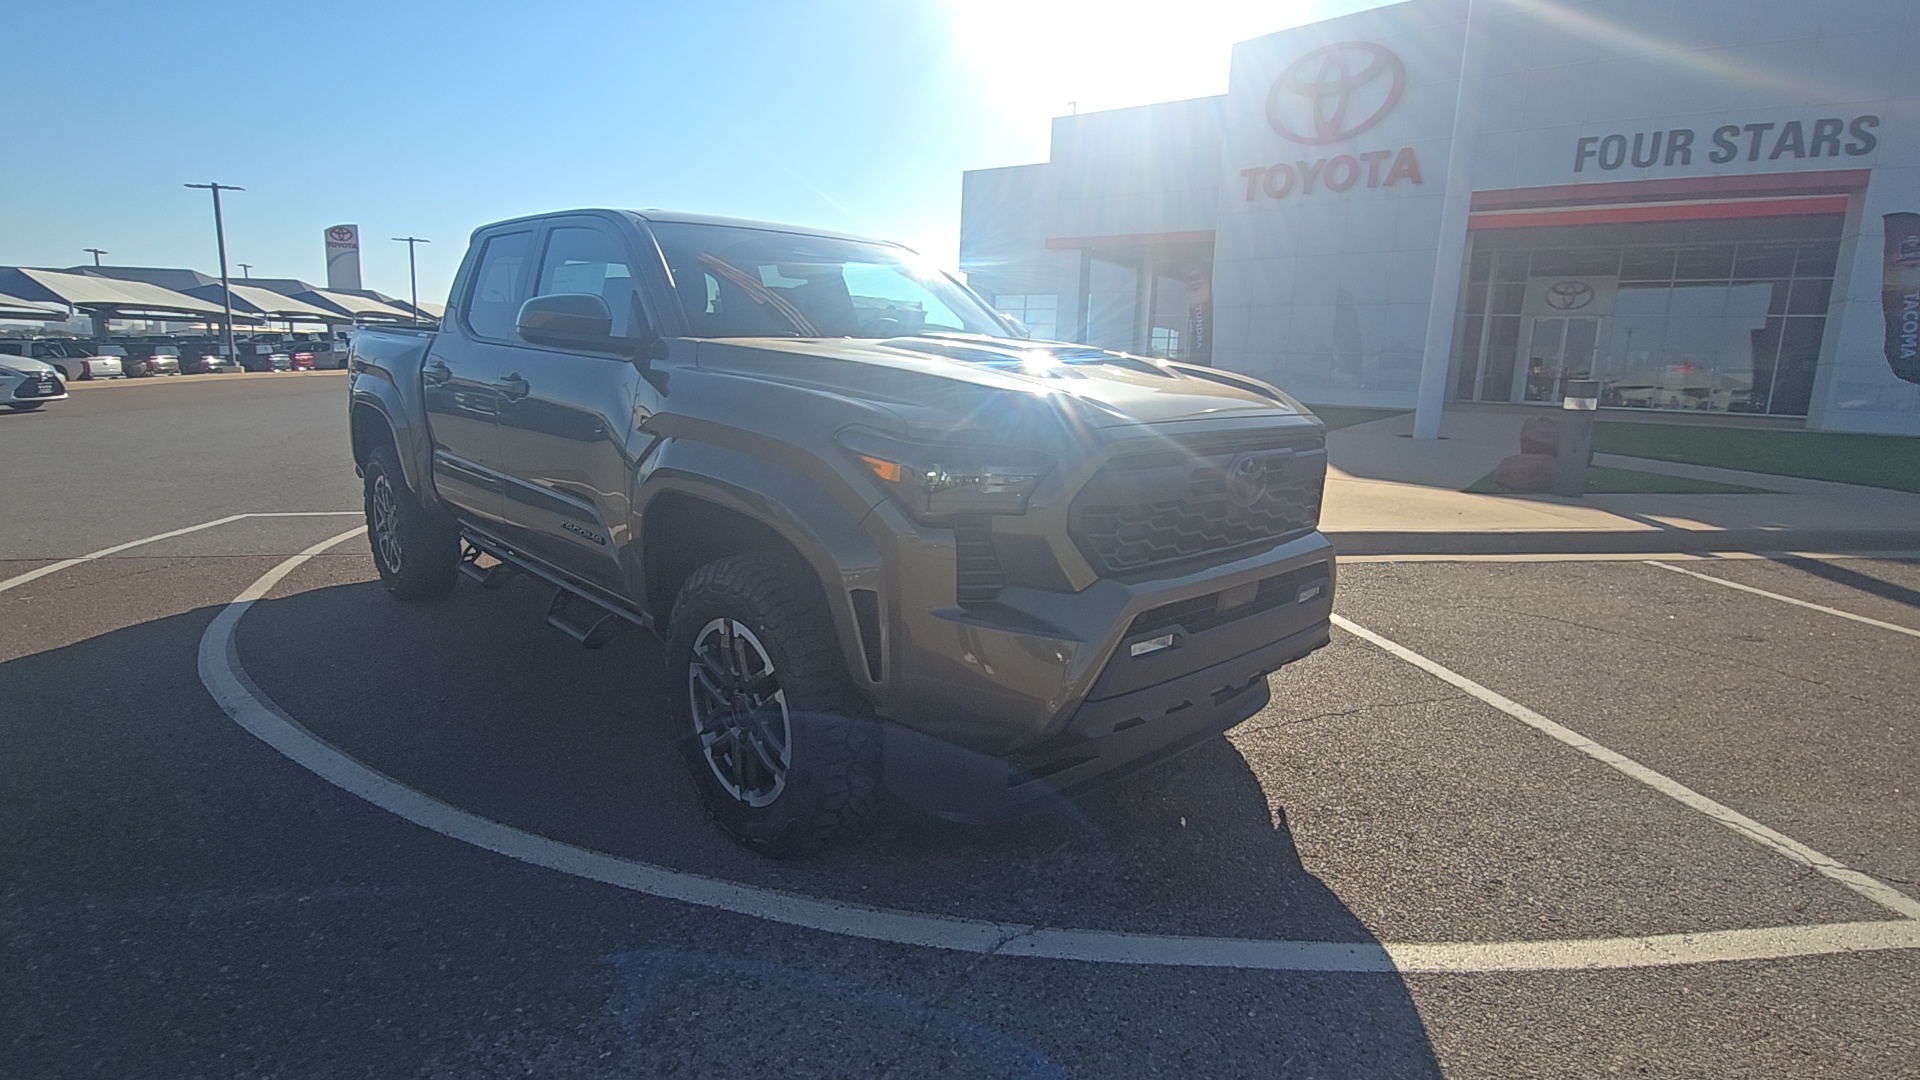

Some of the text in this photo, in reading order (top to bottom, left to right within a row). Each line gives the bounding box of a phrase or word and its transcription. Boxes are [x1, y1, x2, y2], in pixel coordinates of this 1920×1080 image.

[1574, 115, 1880, 172] FOUR STARS
[1240, 147, 1422, 201] TOYOTA
[327, 241, 358, 249] TOYOTA
[1900, 291, 1920, 359] TACOMA
